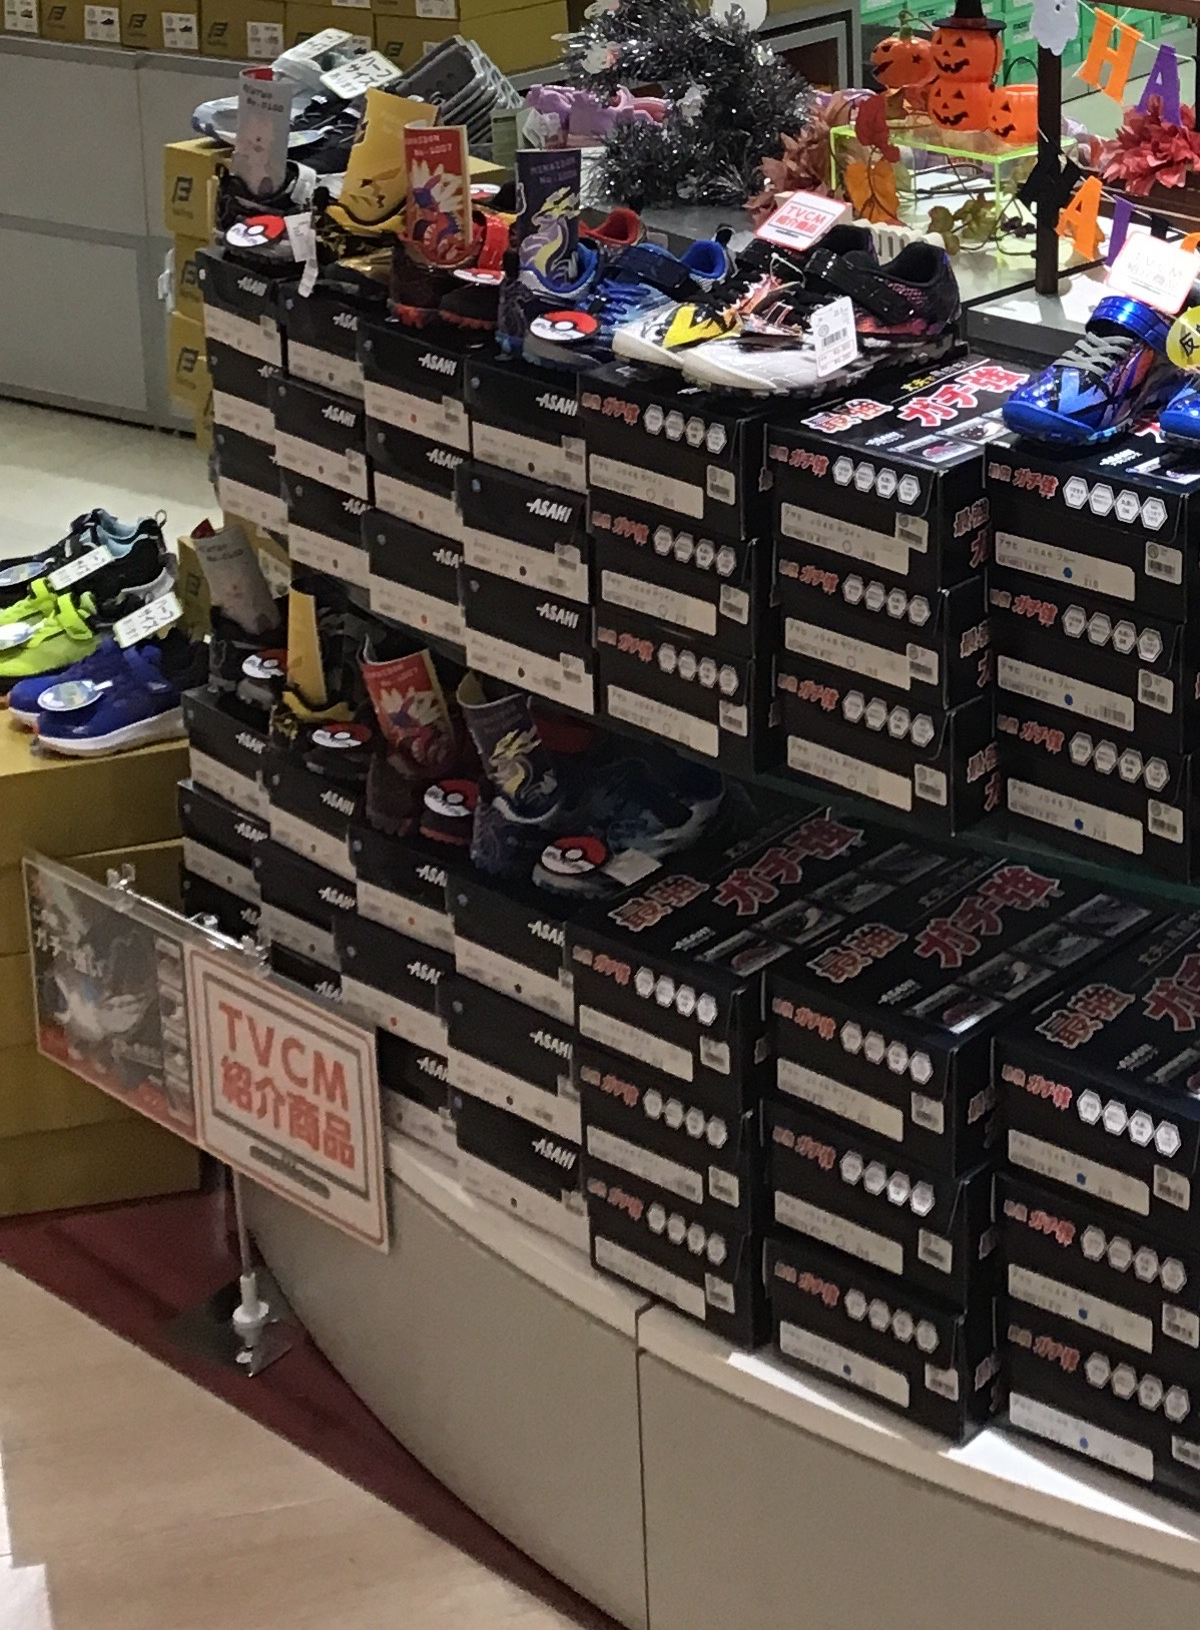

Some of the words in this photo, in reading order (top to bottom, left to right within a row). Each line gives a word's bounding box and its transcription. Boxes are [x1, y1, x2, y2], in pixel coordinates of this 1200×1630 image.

[787, 205, 826, 224] TVCM
[418, 351, 457, 376] ASAHI
[535, 392, 578, 417] ASAHI
[897, 365, 1030, 428] ガチ強
[788, 448, 830, 479] ガチ強
[1011, 467, 1058, 500] ガチ強
[526, 498, 573, 524] ASAHI
[536, 602, 580, 630] ASAHI
[1012, 594, 1058, 628] ガチ強
[1018, 720, 1065, 753] ガチ強
[713, 817, 865, 917] ガチ強
[914, 865, 1066, 970] ガチ強
[1036, 981, 1137, 1050] 最強
[218, 1001, 351, 1111] TVCM
[528, 1029, 573, 1061] ASAHI
[219, 1056, 356, 1170] 紹介商品
[530, 1138, 576, 1170] ASAHI
